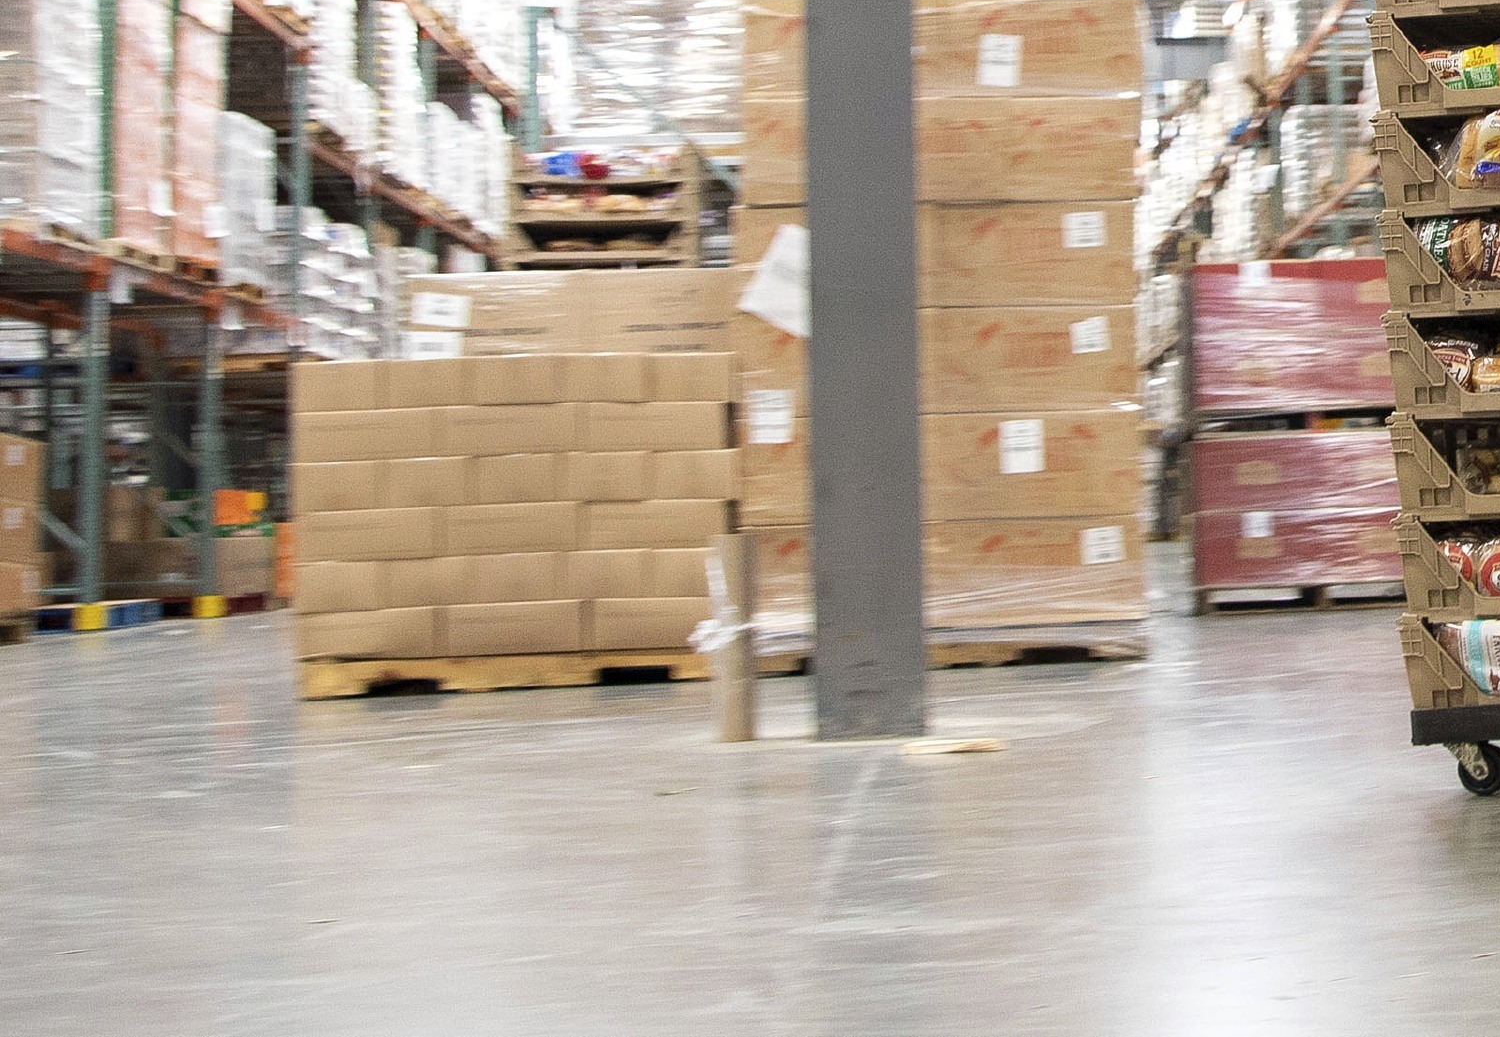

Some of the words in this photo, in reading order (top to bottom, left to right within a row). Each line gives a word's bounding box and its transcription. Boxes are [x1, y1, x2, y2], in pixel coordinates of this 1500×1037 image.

[1472, 48, 1484, 59] 12
[1429, 58, 1460, 72] HOUSE
[1464, 57, 1493, 68] COUNT
[1432, 217, 1451, 266] OATMEA
